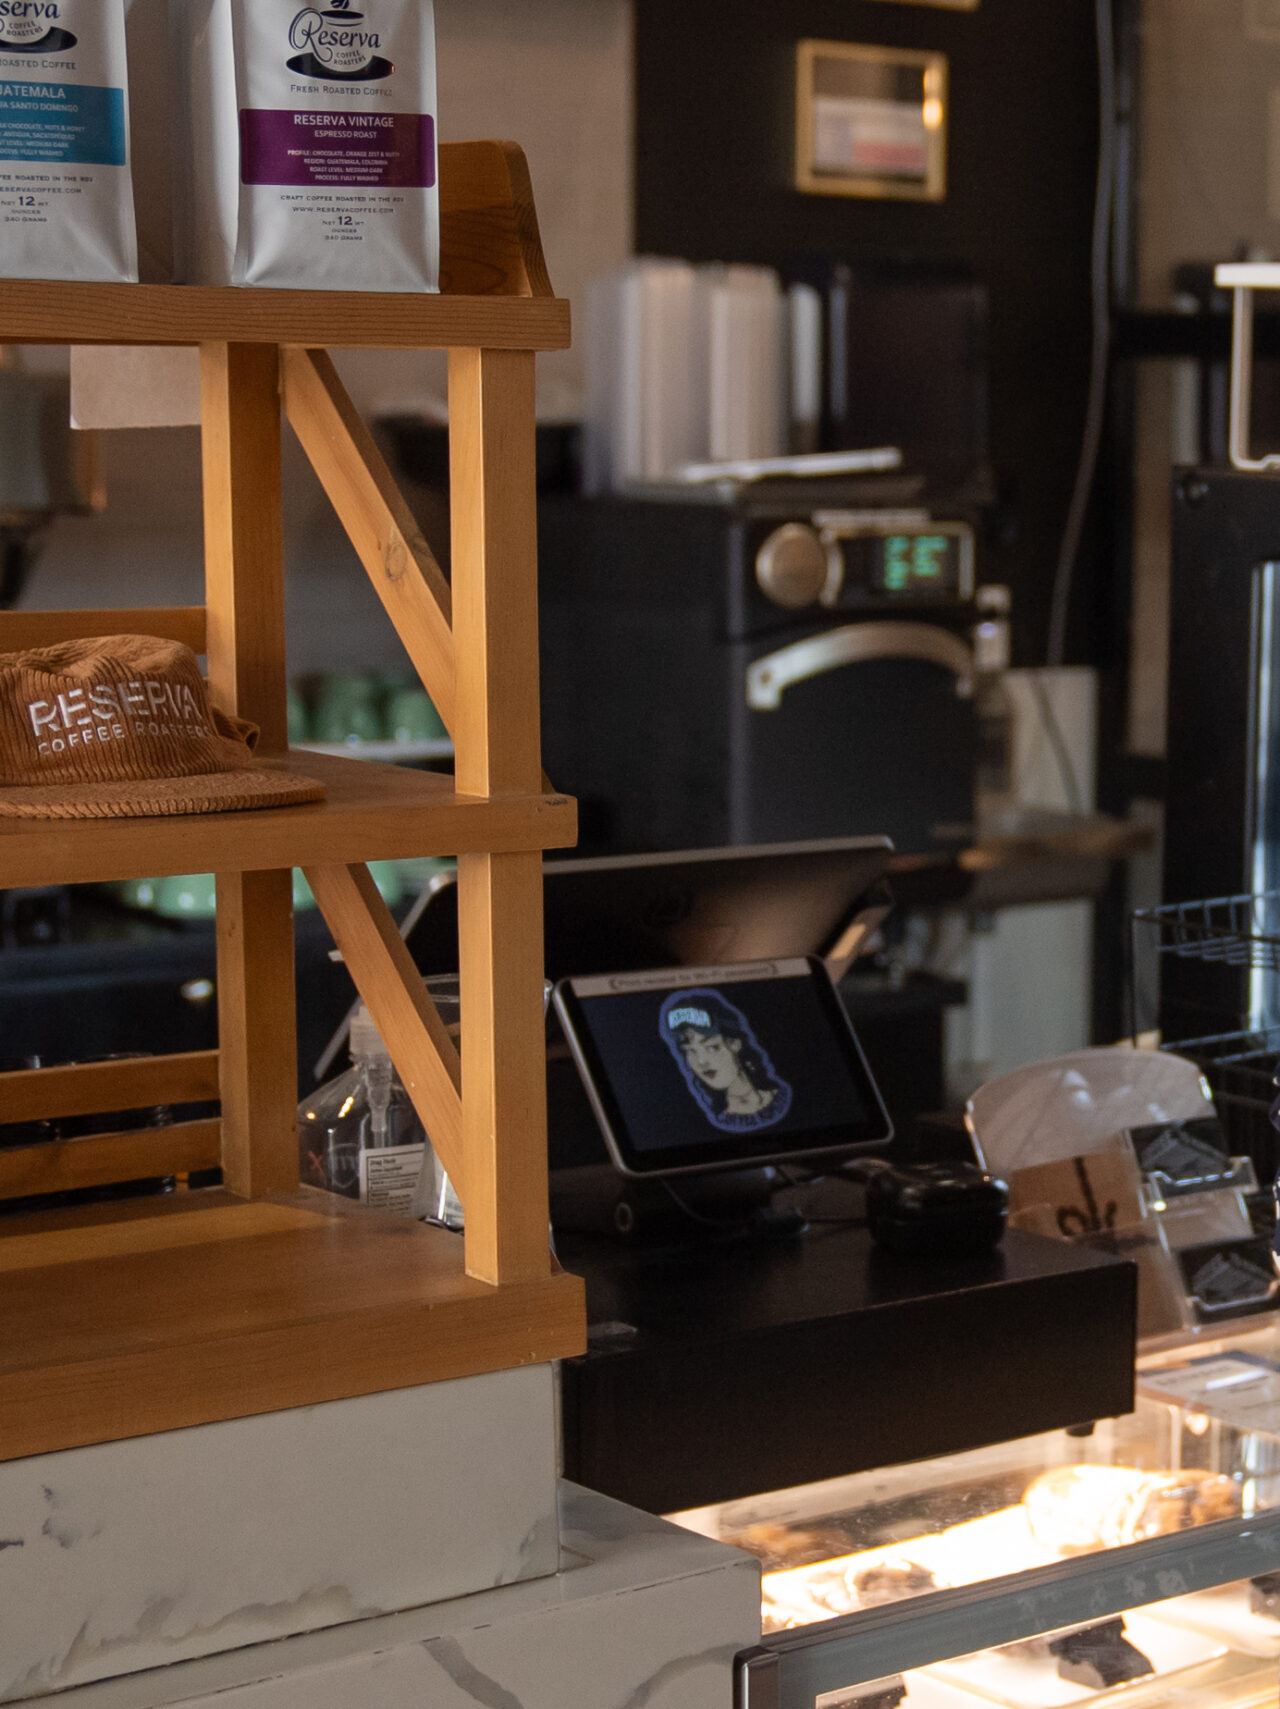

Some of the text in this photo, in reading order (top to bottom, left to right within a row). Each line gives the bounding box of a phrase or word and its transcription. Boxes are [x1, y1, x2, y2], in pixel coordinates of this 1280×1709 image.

[0, 0, 61, 19] serva
[9, 20, 36, 29] COFFEE
[6, 26, 44, 37] ROASTERS
[288, 7, 382, 62] Reserva
[335, 50, 361, 59] COFFEE
[333, 56, 366, 66] ROASTERS
[0, 85, 66, 99] ATEMALA
[290, 84, 319, 93] FRESH
[323, 85, 361, 95] ROASTED
[10, 101, 39, 111] SANTO
[40, 103, 78, 112] DOMINGO
[294, 114, 395, 128] RESERVA VINTAGE
[314, 130, 377, 139] ESPRESSO ROAST
[18, 196, 36, 207] 12
[337, 216, 353, 226] 12
[28, 681, 203, 736] RESERVA
[37, 720, 212, 756] COFFEE ROASTERS
